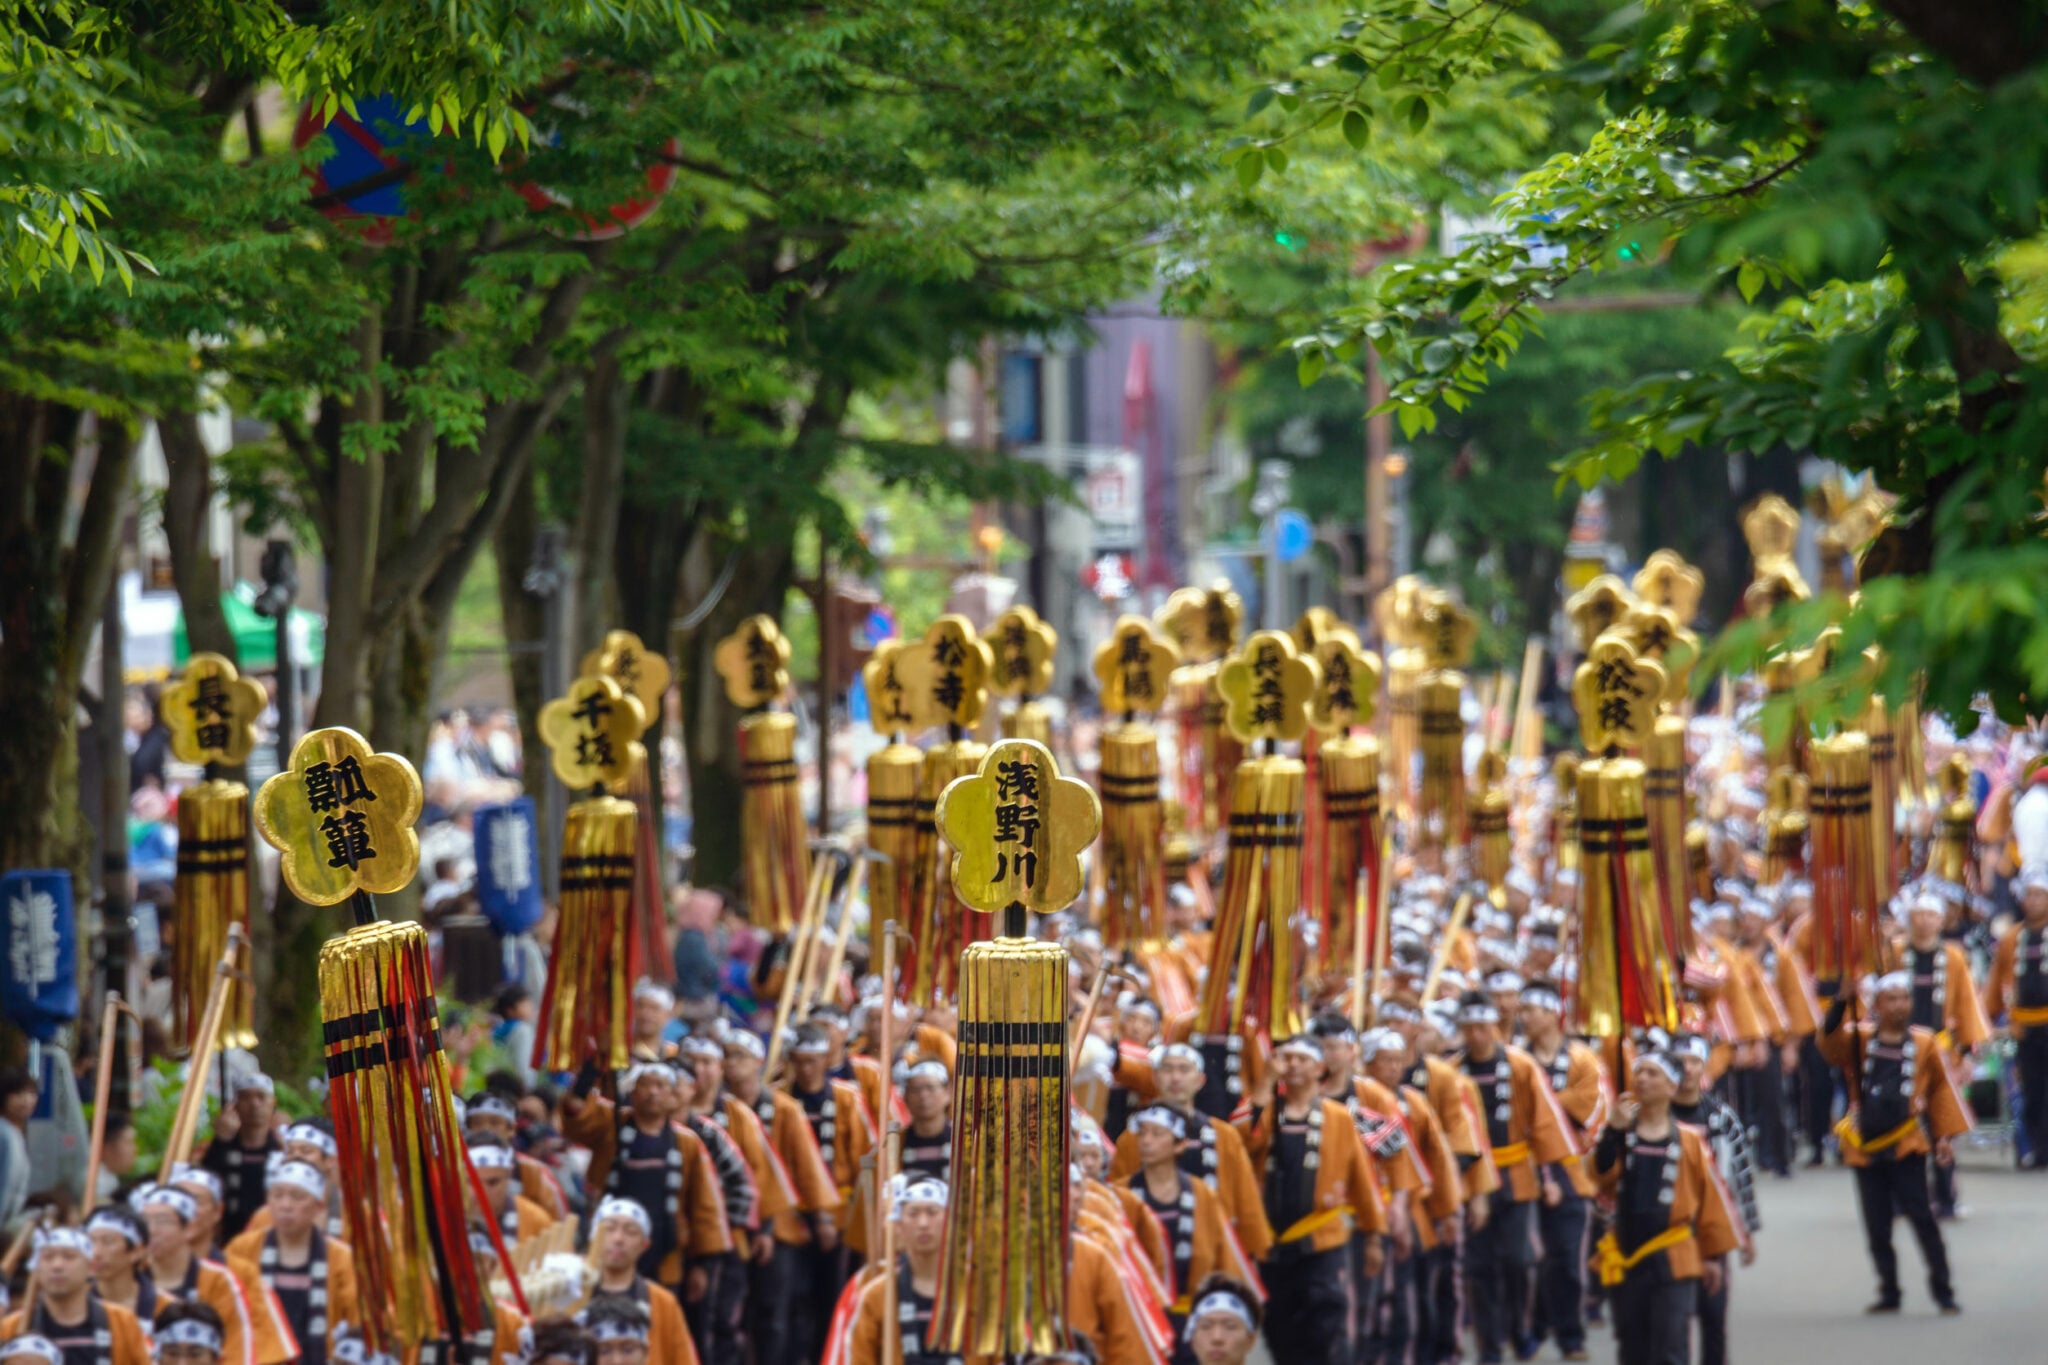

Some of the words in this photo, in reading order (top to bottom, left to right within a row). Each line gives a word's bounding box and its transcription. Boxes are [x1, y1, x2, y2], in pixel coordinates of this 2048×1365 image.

[189, 676, 234, 750] 長田
[989, 761, 1040, 889] 浅野川
